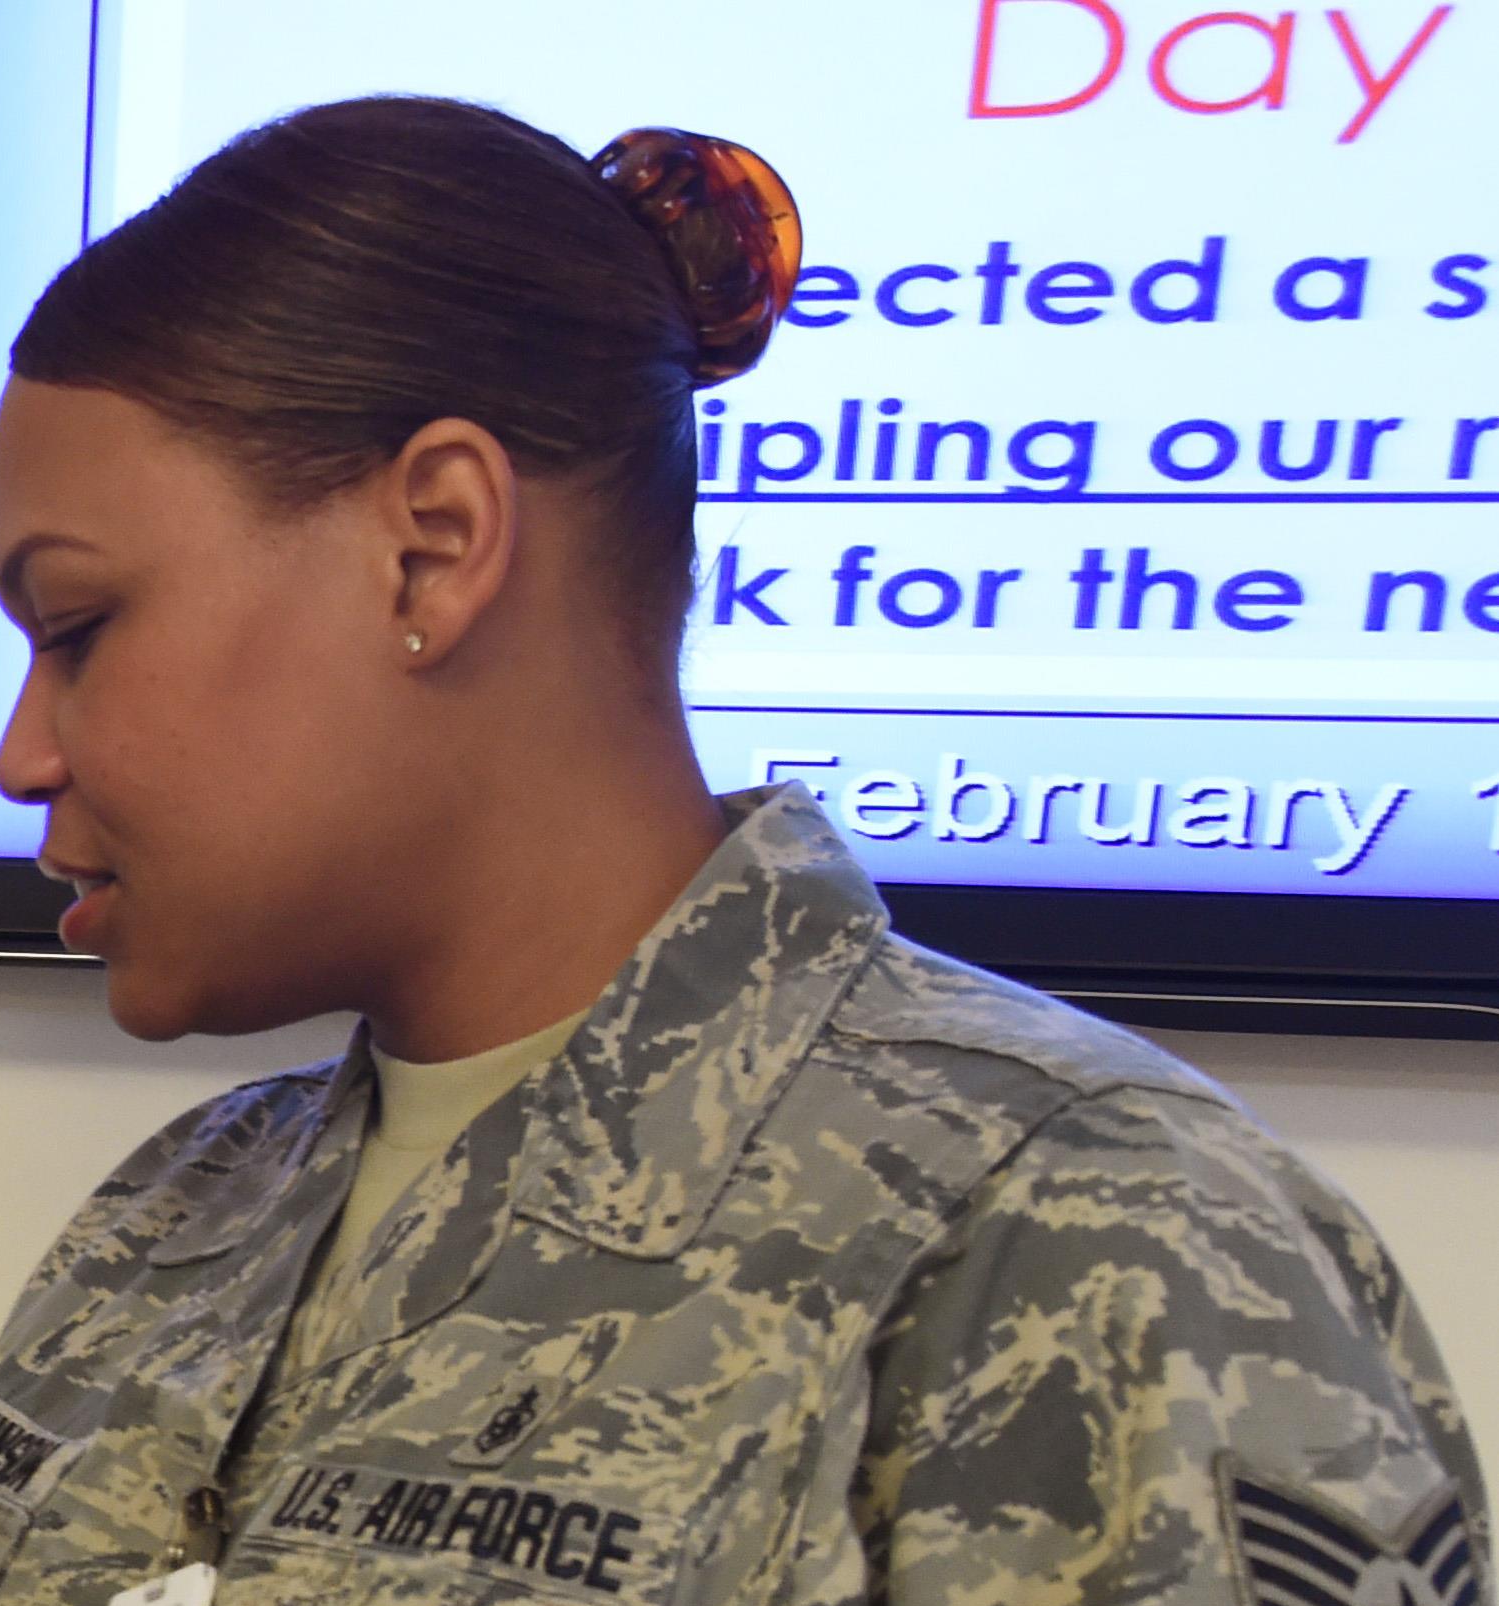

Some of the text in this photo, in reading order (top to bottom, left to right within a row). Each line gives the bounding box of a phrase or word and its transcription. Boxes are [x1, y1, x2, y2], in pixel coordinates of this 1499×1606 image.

[967, 0, 1455, 144] Day
[783, 236, 1227, 328] ected
[1273, 256, 1371, 323] a
[698, 398, 1499, 502] ipling our r
[712, 545, 1499, 633] k for the ne
[353, 1479, 452, 1547] AIR
[441, 1484, 642, 1593] FORCE
